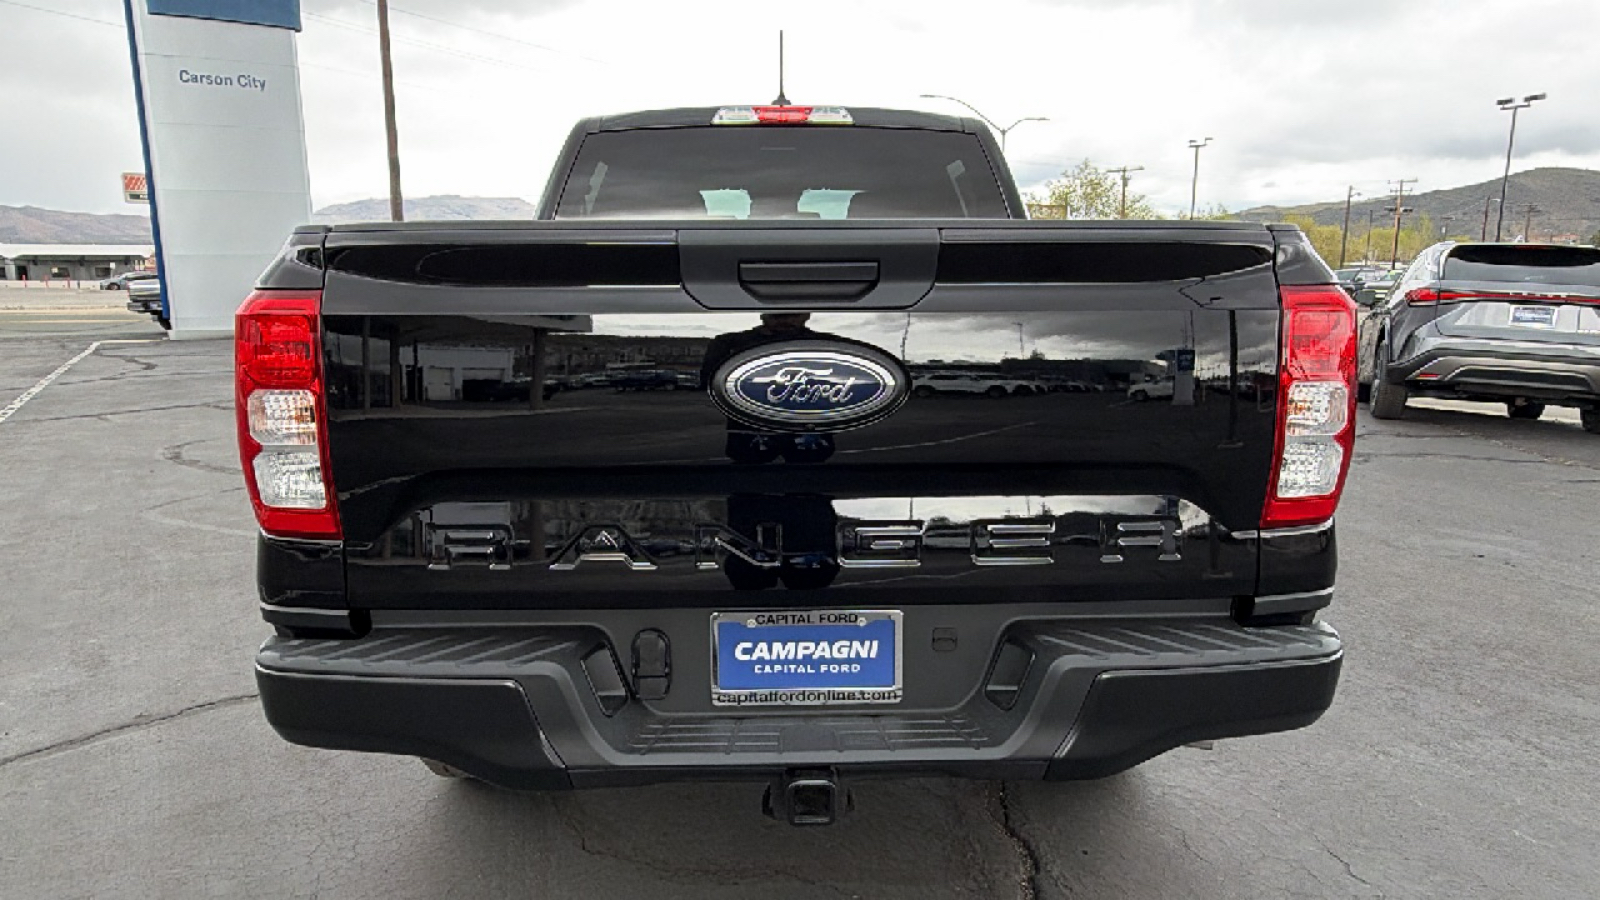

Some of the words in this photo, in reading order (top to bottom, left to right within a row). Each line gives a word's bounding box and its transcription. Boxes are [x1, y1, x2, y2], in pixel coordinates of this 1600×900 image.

[178, 69, 234, 87] Carson
[236, 74, 267, 92] City
[766, 366, 855, 404] Ford
[427, 519, 1183, 571] RANGER
[754, 614, 816, 626] CAPITAL
[818, 613, 859, 625] FORD
[734, 640, 880, 661] CAMPAGNI
[754, 664, 816, 674] CAPITAL
[819, 663, 862, 674] FORD
[716, 689, 898, 705] capitalfordonline.com
